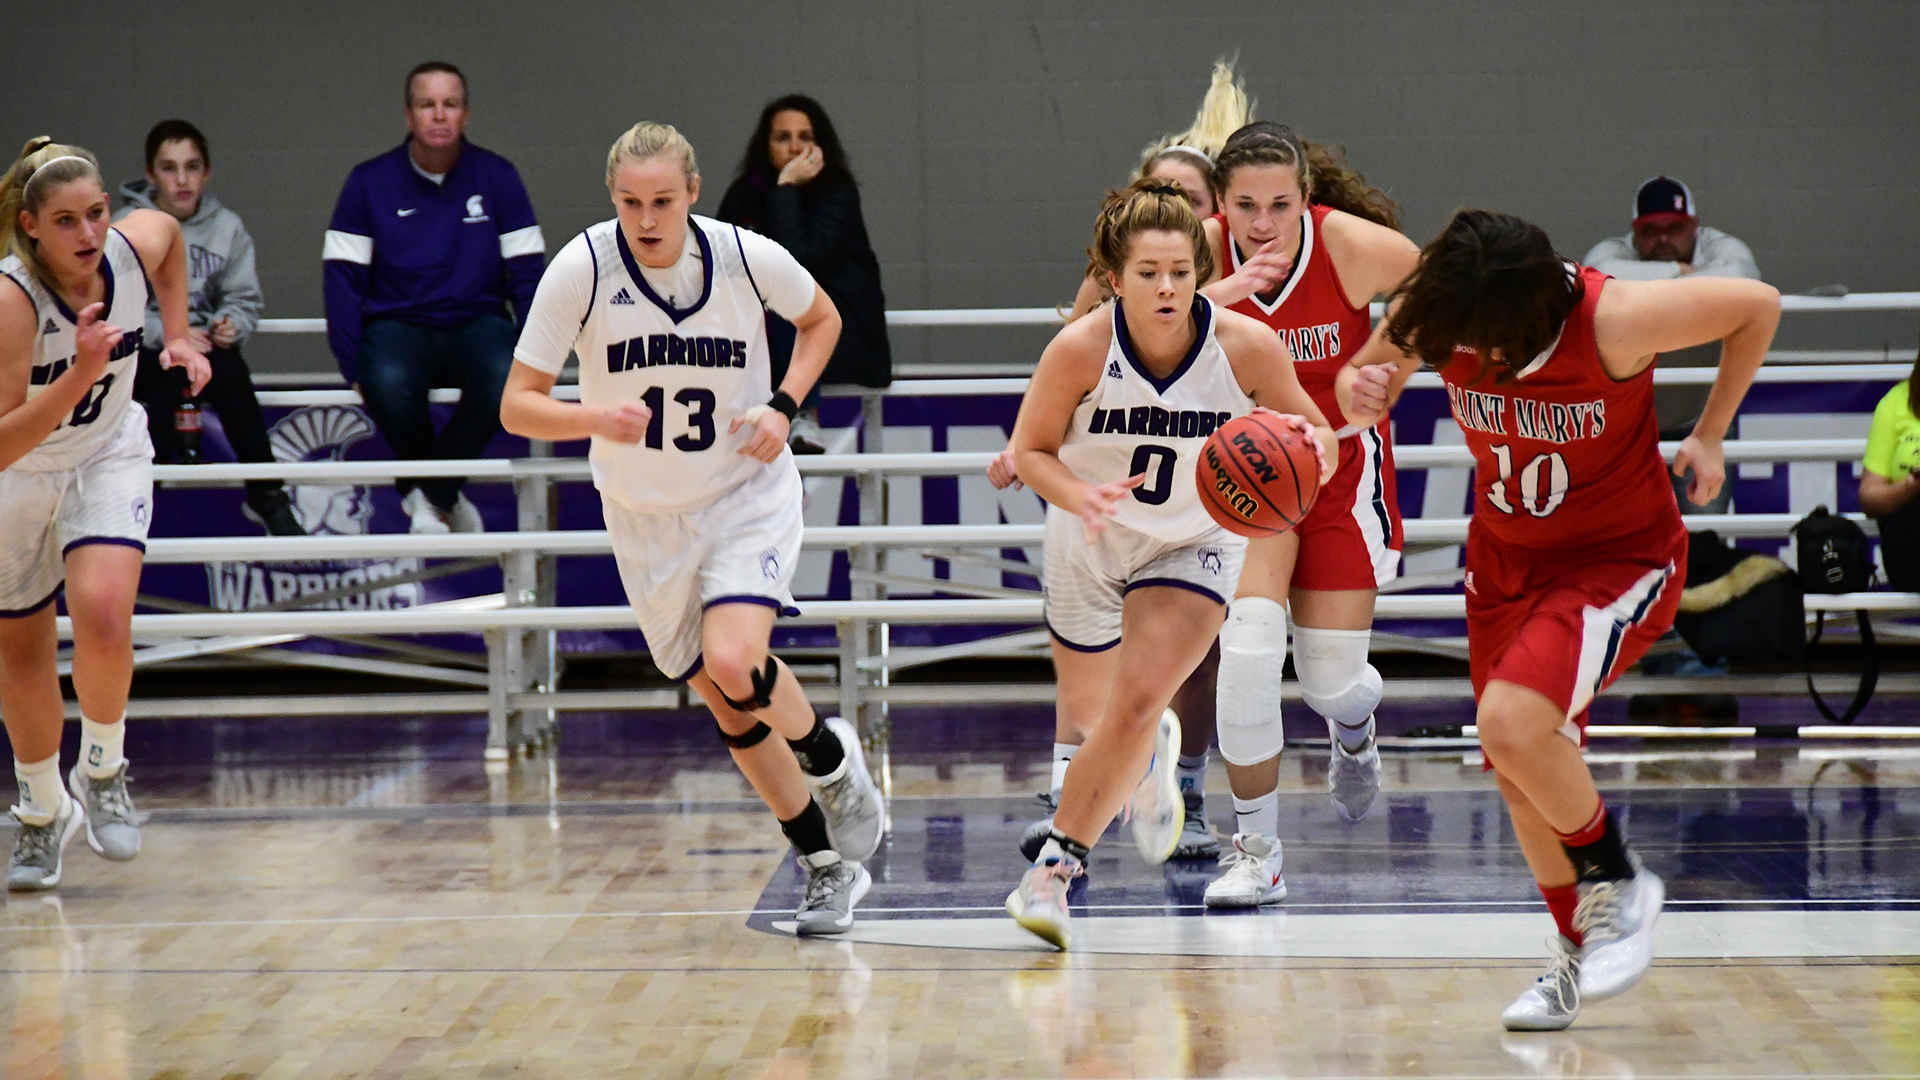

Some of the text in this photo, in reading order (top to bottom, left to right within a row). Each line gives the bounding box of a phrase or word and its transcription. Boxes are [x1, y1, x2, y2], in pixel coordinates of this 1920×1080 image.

[606, 333, 747, 374] WARRIORS
[1453, 343, 1478, 355] didas
[640, 385, 717, 452] 13
[1447, 381, 1606, 445] SAINT MARY'S
[1129, 444, 1178, 506] 0
[1205, 443, 1259, 519] Wilson
[1232, 430, 1279, 485] NCAA
[1486, 442, 1570, 519] 10
